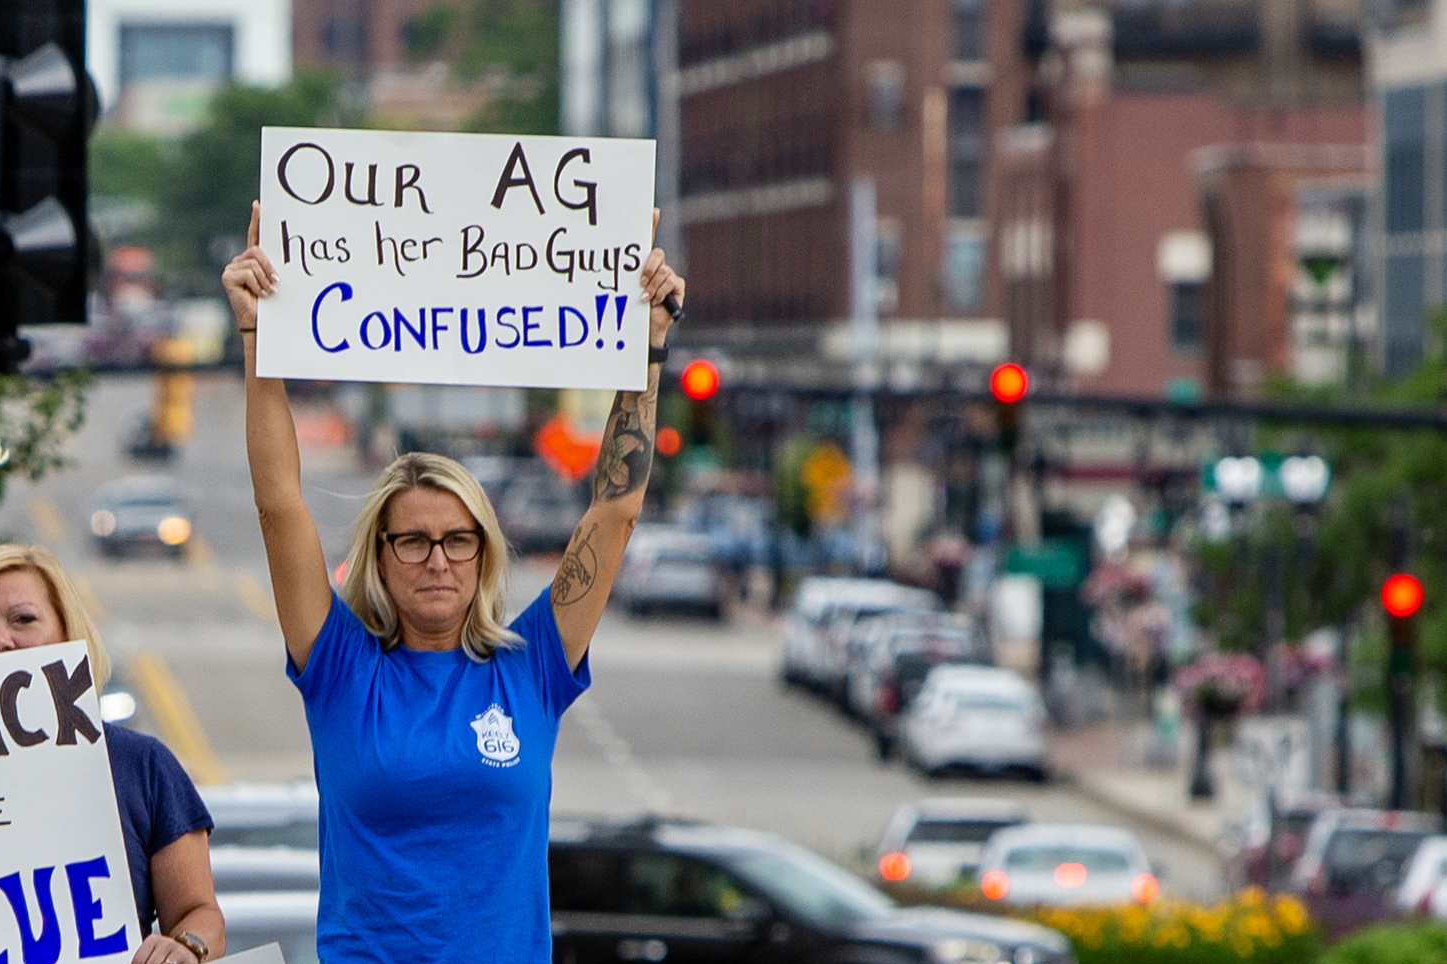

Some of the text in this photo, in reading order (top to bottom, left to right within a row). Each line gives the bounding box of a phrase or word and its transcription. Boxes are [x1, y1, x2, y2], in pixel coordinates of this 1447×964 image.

[277, 141, 598, 226] OUR AG
[281, 220, 351, 275] has
[375, 220, 442, 276] her
[311, 282, 628, 354] CONFUSED!!
[484, 739, 514, 753] 616
